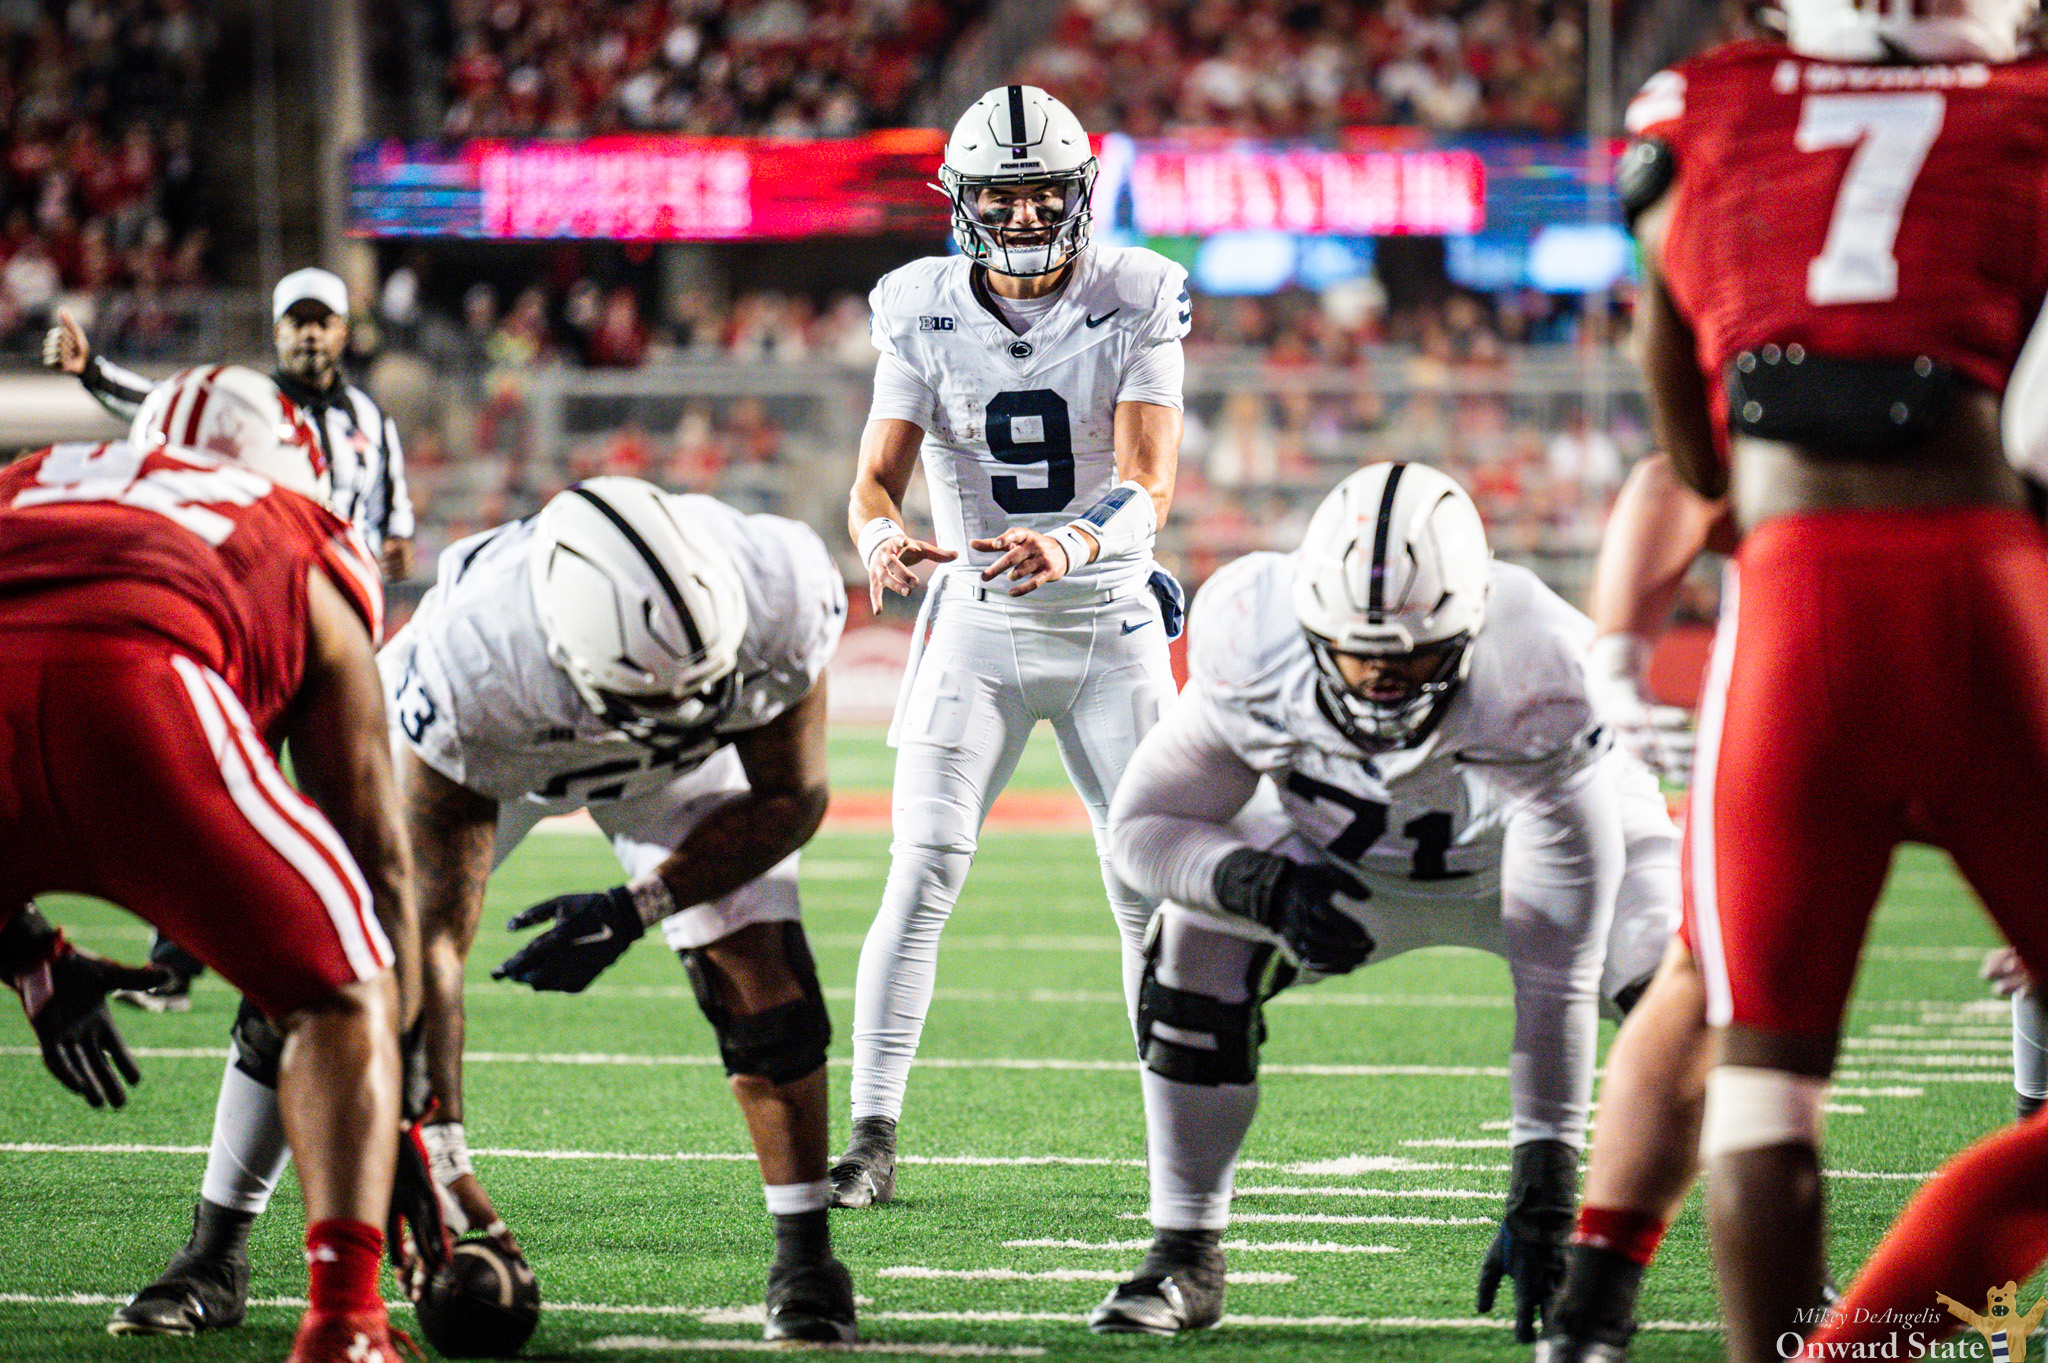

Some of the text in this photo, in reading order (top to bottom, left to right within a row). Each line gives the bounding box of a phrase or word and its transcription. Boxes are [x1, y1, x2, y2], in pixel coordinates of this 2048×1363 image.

[1795, 91, 1946, 306] 7
[985, 388, 1076, 515] 9
[1287, 772, 1473, 880] 71
